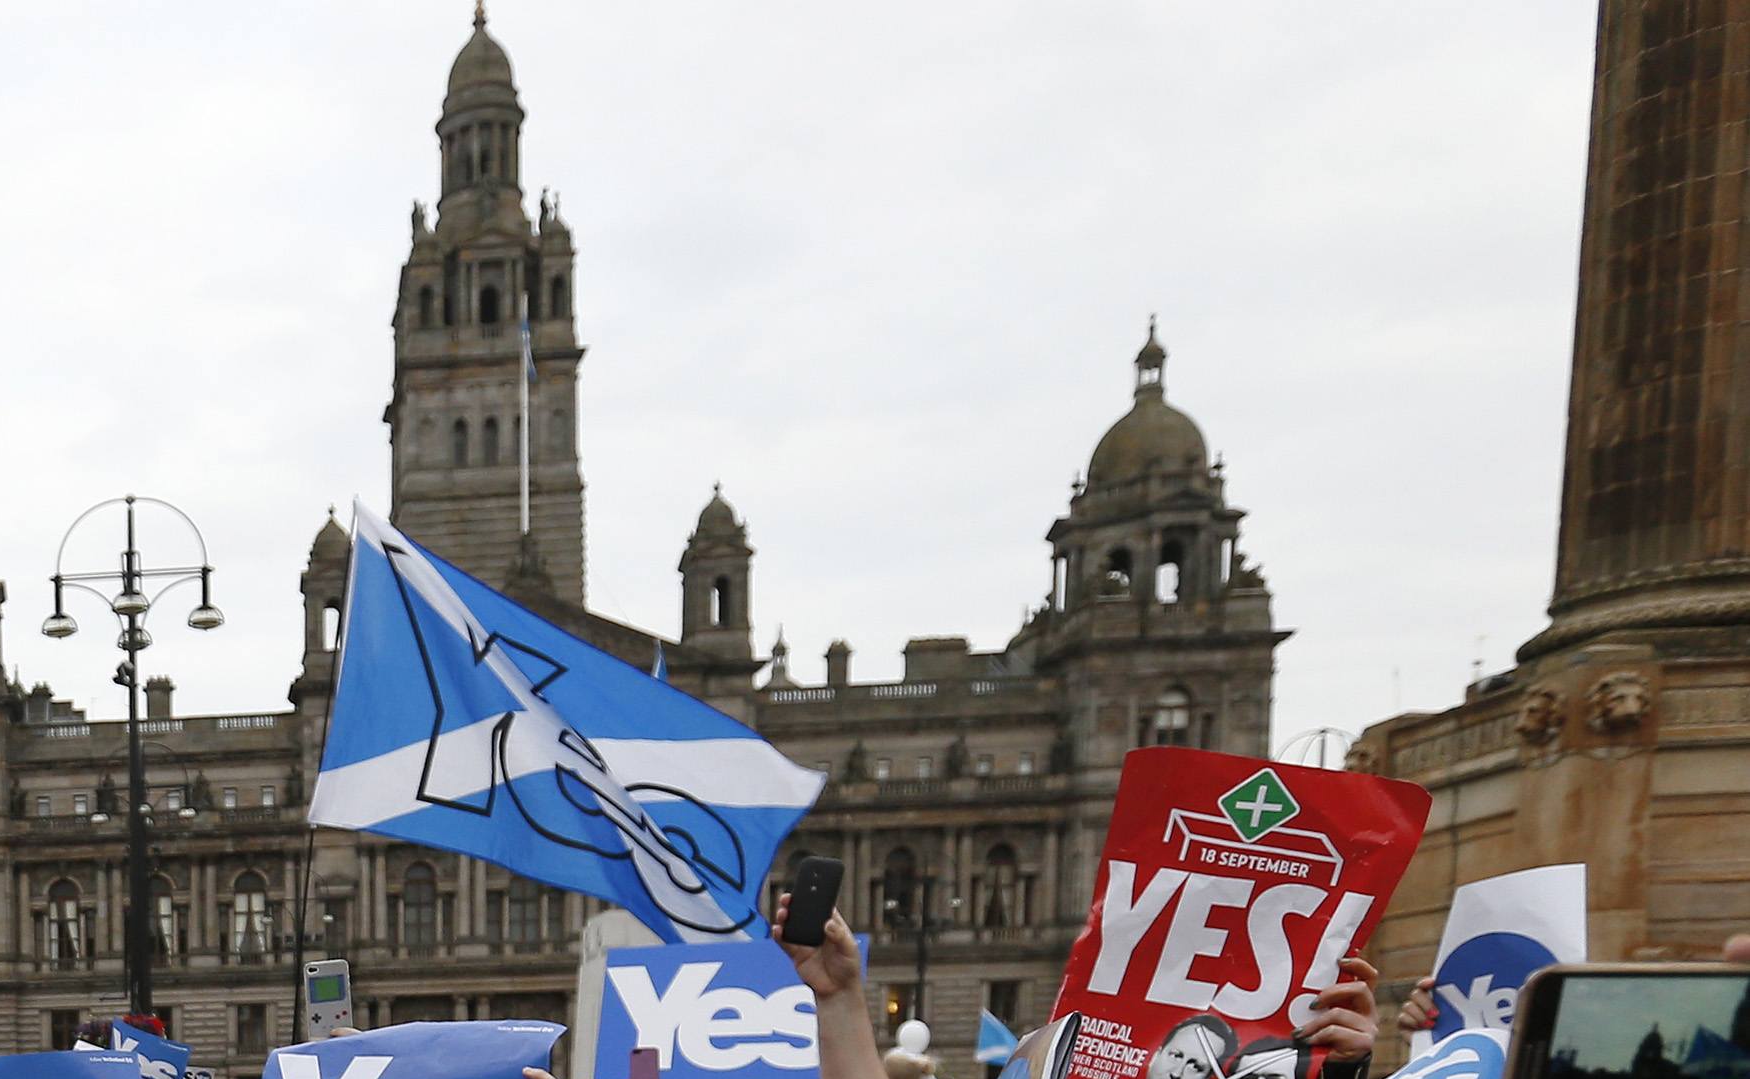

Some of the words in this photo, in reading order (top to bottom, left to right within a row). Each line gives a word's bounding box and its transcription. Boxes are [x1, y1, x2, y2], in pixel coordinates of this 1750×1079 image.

[1200, 847, 1216, 864] 18
[1218, 850, 1311, 878] SEPTEMBER
[1086, 859, 1375, 1028] YES!
[607, 961, 819, 1072] Yes
[1436, 974, 1520, 1029] Ye
[1081, 1015, 1132, 1043] RADICAL
[1074, 1035, 1149, 1067] EPENDENCE
[1093, 1057, 1139, 1078] SCOTLAND
